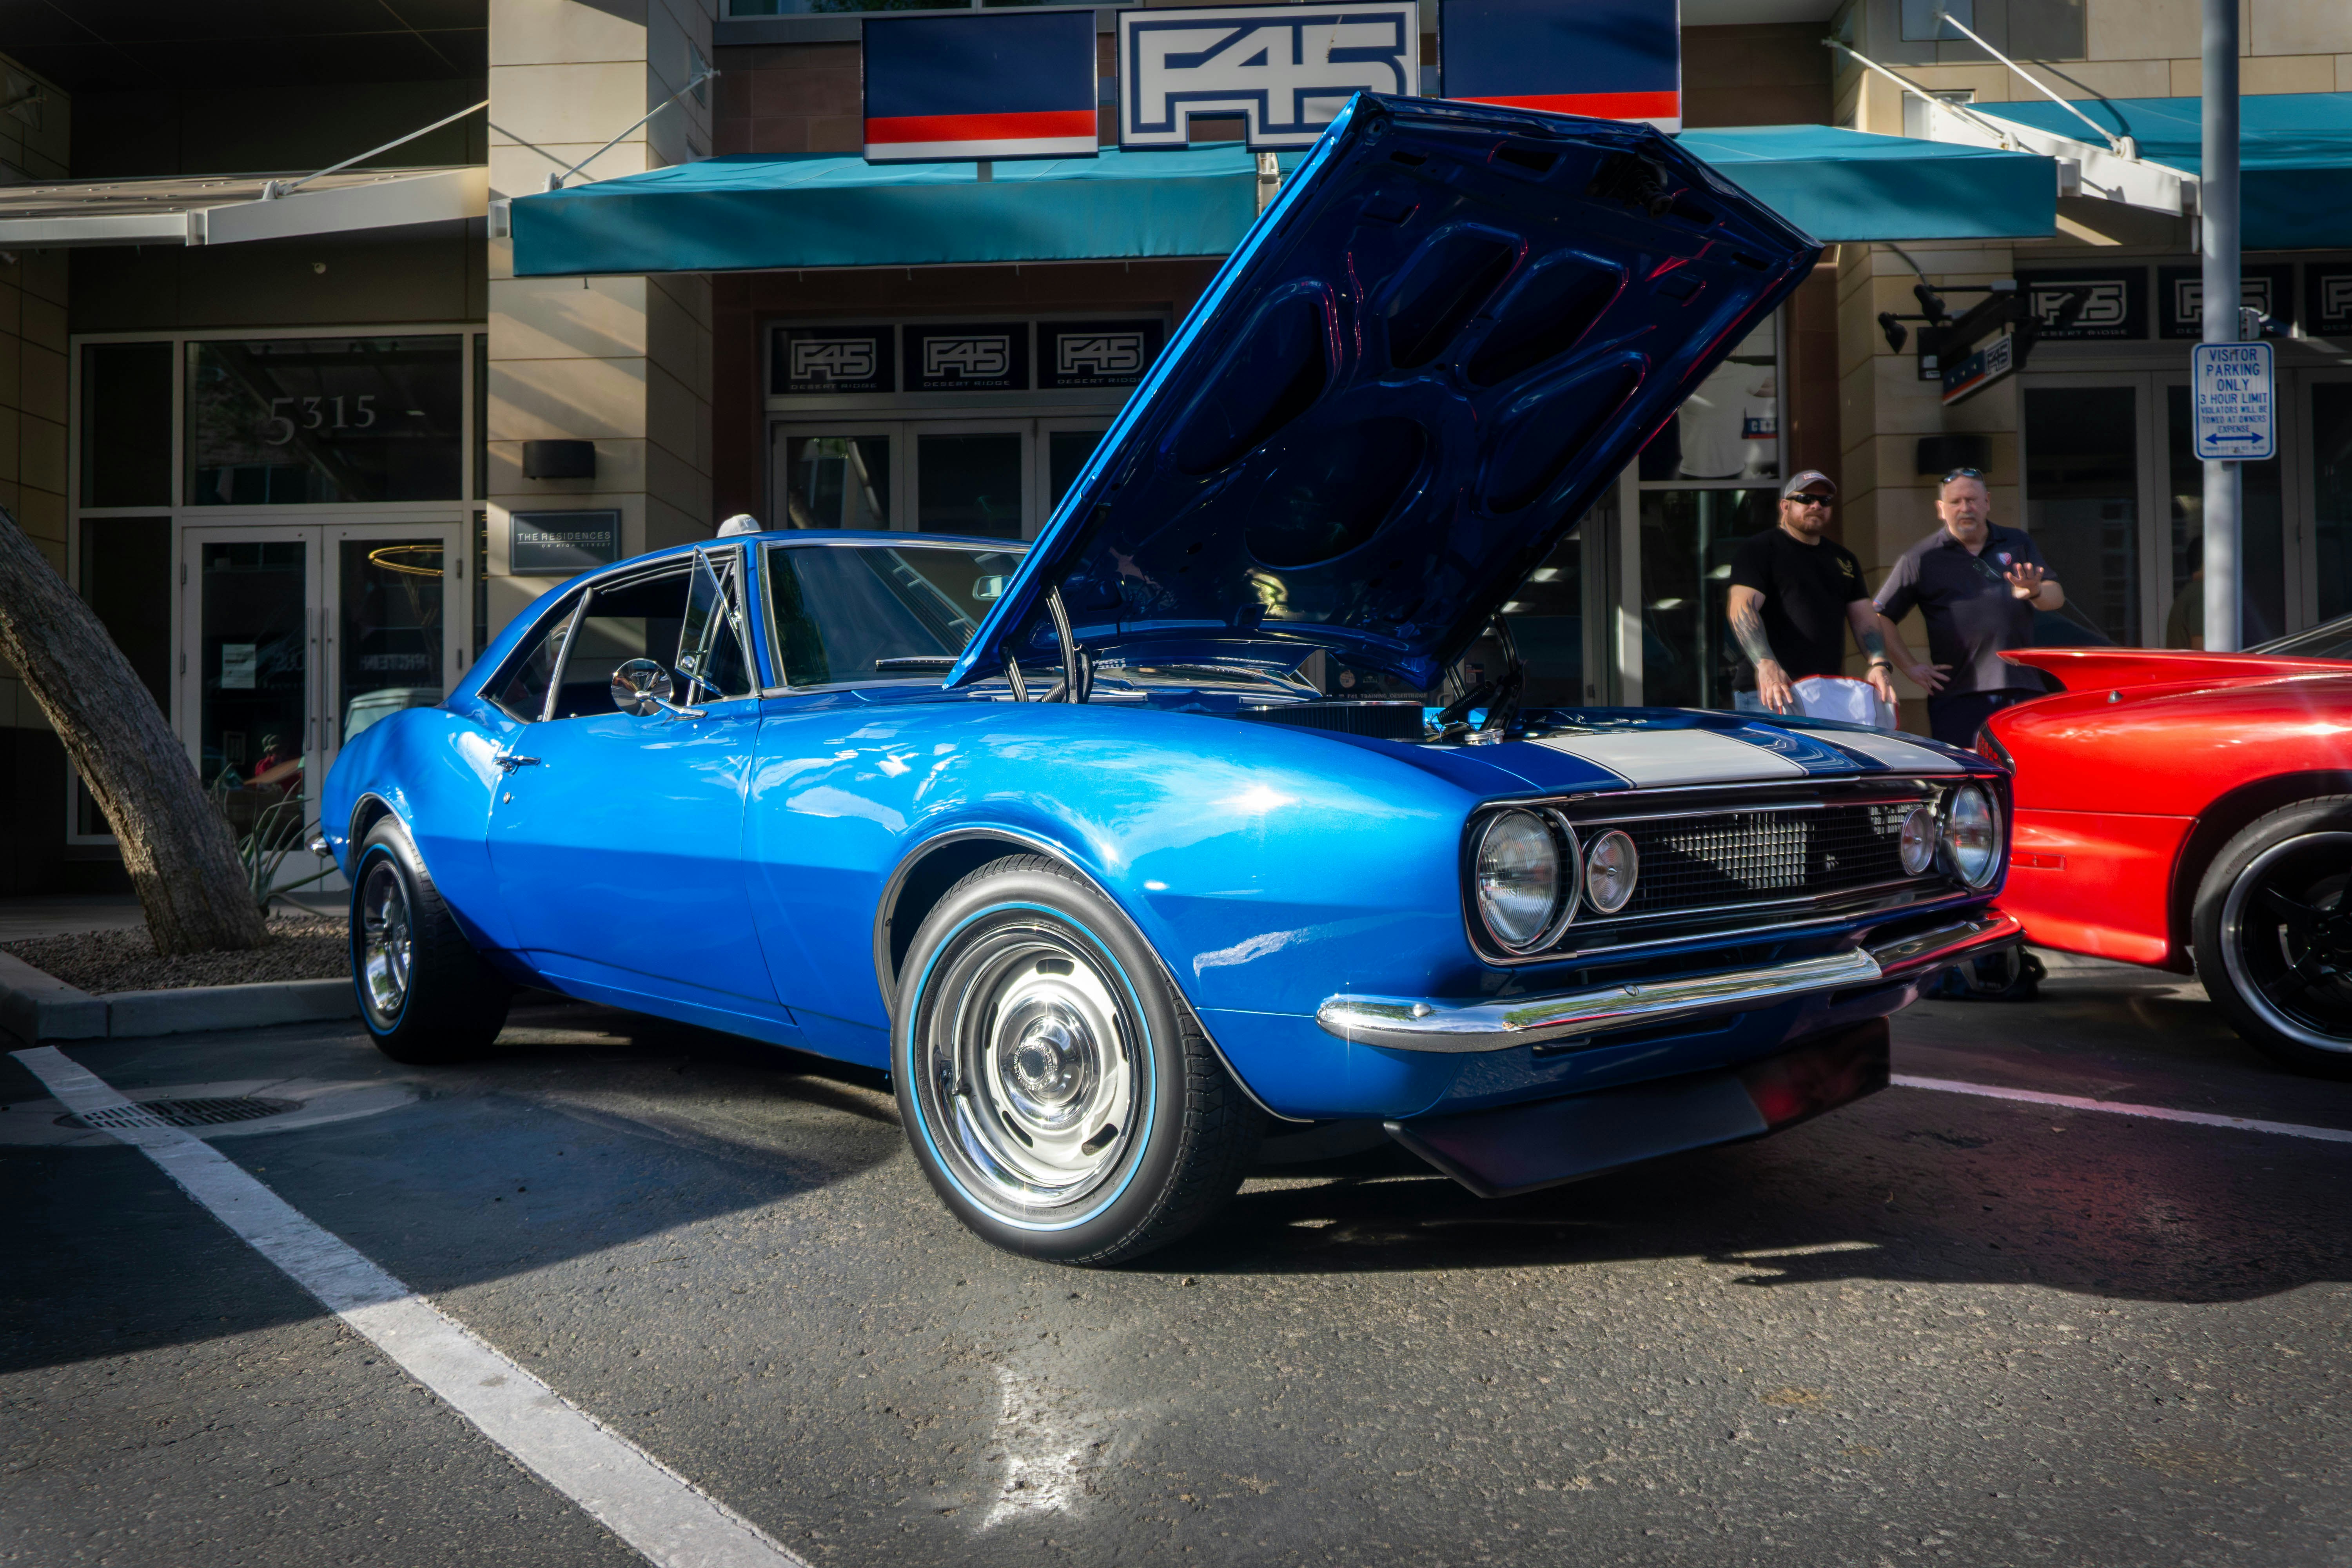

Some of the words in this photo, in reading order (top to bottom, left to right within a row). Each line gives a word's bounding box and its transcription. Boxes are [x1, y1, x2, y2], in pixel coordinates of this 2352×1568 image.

[1128, 11, 1408, 143] F45
[792, 339, 874, 377] F45
[924, 336, 1009, 376] F45
[1056, 334, 1143, 373] F45
[2209, 348, 2257, 362] VISITOR
[2206, 363, 2260, 377] PARKING
[2217, 378, 2249, 392] ONLY
[2200, 394, 2207, 405] 3
[2210, 393, 2238, 404] HOUR
[2241, 392, 2268, 403] LIMIT
[2201, 406, 2238, 414] VIOLATORS
[2259, 405, 2268, 413] BE
[263, 395, 376, 445] 5315
[2202, 416, 2225, 424] TOWED
[2227, 415, 2237, 423] AT
[2239, 414, 2267, 423] OWNERS
[2218, 425, 2250, 434] EXPENSE
[517, 533, 539, 541] THE
[541, 531, 611, 541] RESIDENCES
